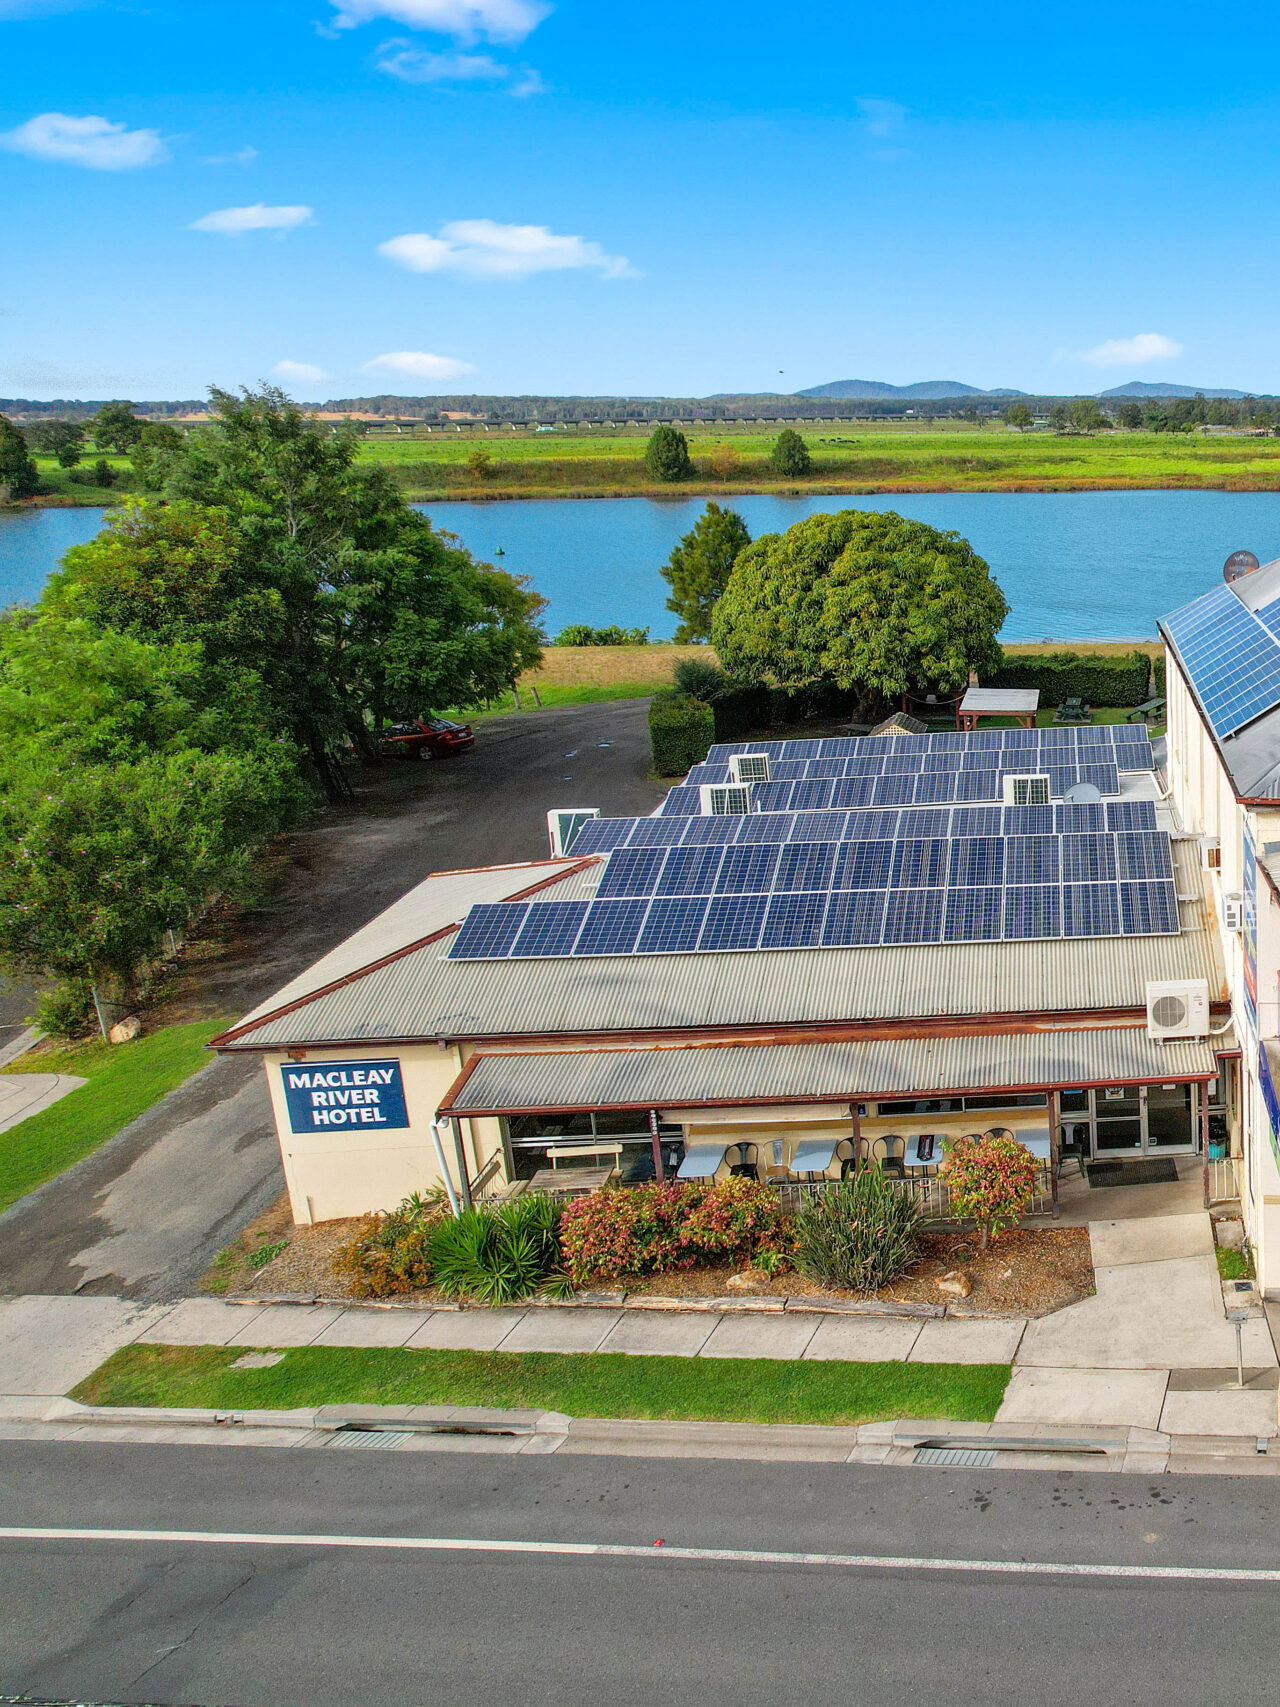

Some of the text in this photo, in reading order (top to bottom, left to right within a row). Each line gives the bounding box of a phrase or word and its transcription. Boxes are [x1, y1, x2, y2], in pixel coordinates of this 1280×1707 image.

[288, 1068, 395, 1089] MACLEAY
[310, 1088, 380, 1107] RIVER
[312, 1107, 387, 1125] HOTEL
